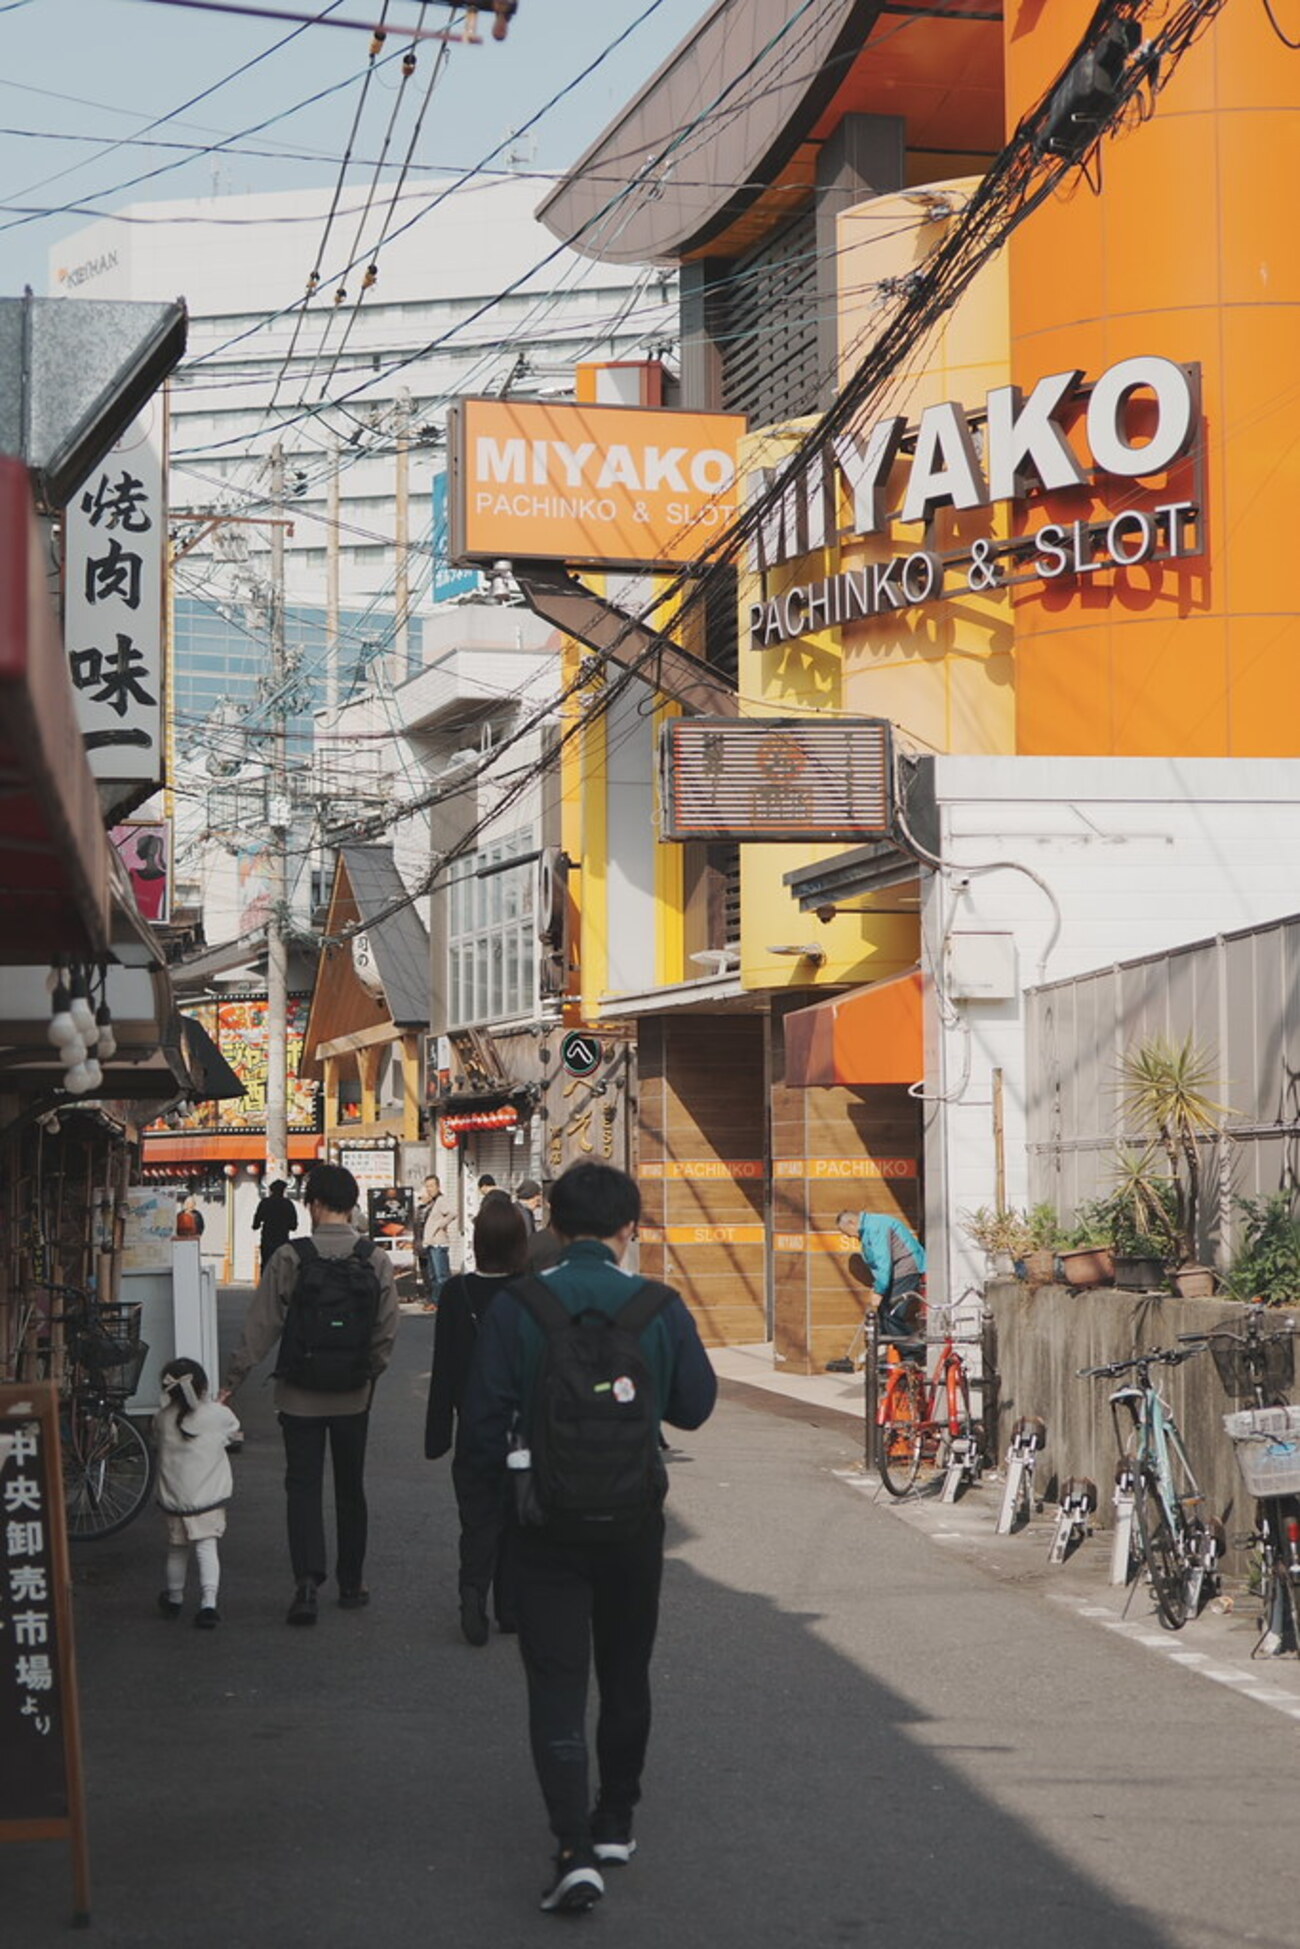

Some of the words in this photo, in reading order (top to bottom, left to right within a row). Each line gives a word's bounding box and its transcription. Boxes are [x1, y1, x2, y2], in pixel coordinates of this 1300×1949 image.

[476, 437, 735, 494] MIYAKO
[749, 356, 1191, 573] MIYAKO
[476, 492, 616, 520] PACHINKO
[633, 501, 650, 523] &
[666, 502, 735, 526] SLOT
[749, 551, 935, 649] PACHINKO
[968, 539, 997, 590] &
[1035, 502, 1192, 577] SLOT
[673, 1162, 755, 1177] PACHINKO
[816, 1159, 907, 1176] PACHINKO
[694, 1228, 737, 1242] SLOT
[4, 1429, 52, 1735] 中央卸売市場より
